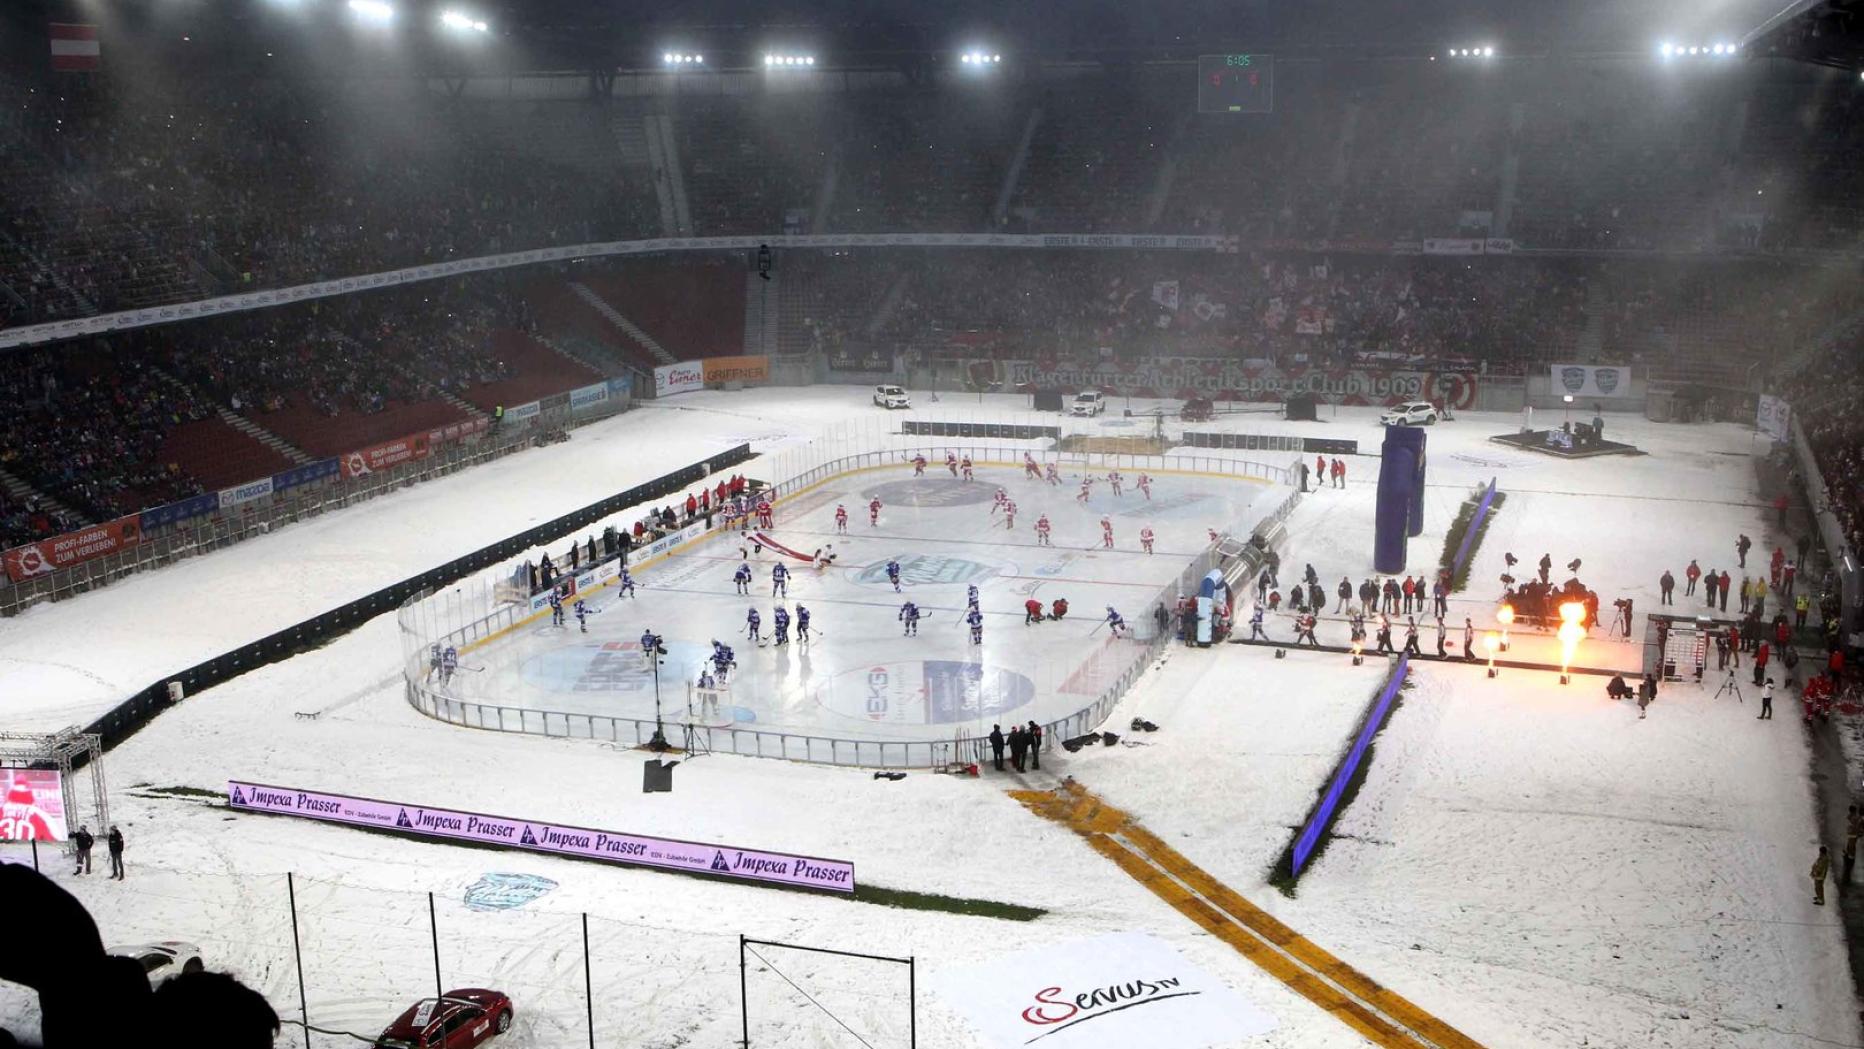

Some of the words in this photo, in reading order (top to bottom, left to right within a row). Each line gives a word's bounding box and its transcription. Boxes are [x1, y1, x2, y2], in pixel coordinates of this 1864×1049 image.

[1226, 55, 1250, 66] 6:05
[706, 367, 764, 382] GRIFFNER
[1367, 377, 1421, 395] 1909
[236, 482, 270, 500] mazda
[55, 529, 108, 553] PROFI-FARBEN
[56, 550, 75, 564] ZUM
[77, 539, 116, 558] VERLIEBEN!
[249, 787, 292, 807] Impexa
[297, 793, 342, 814] Prasser
[415, 809, 462, 831] Impexa
[467, 816, 516, 838] Prasser
[540, 826, 590, 848] Impexa
[595, 834, 648, 856] Prasser
[733, 851, 787, 875] Impexa
[793, 859, 850, 883] Prasser
